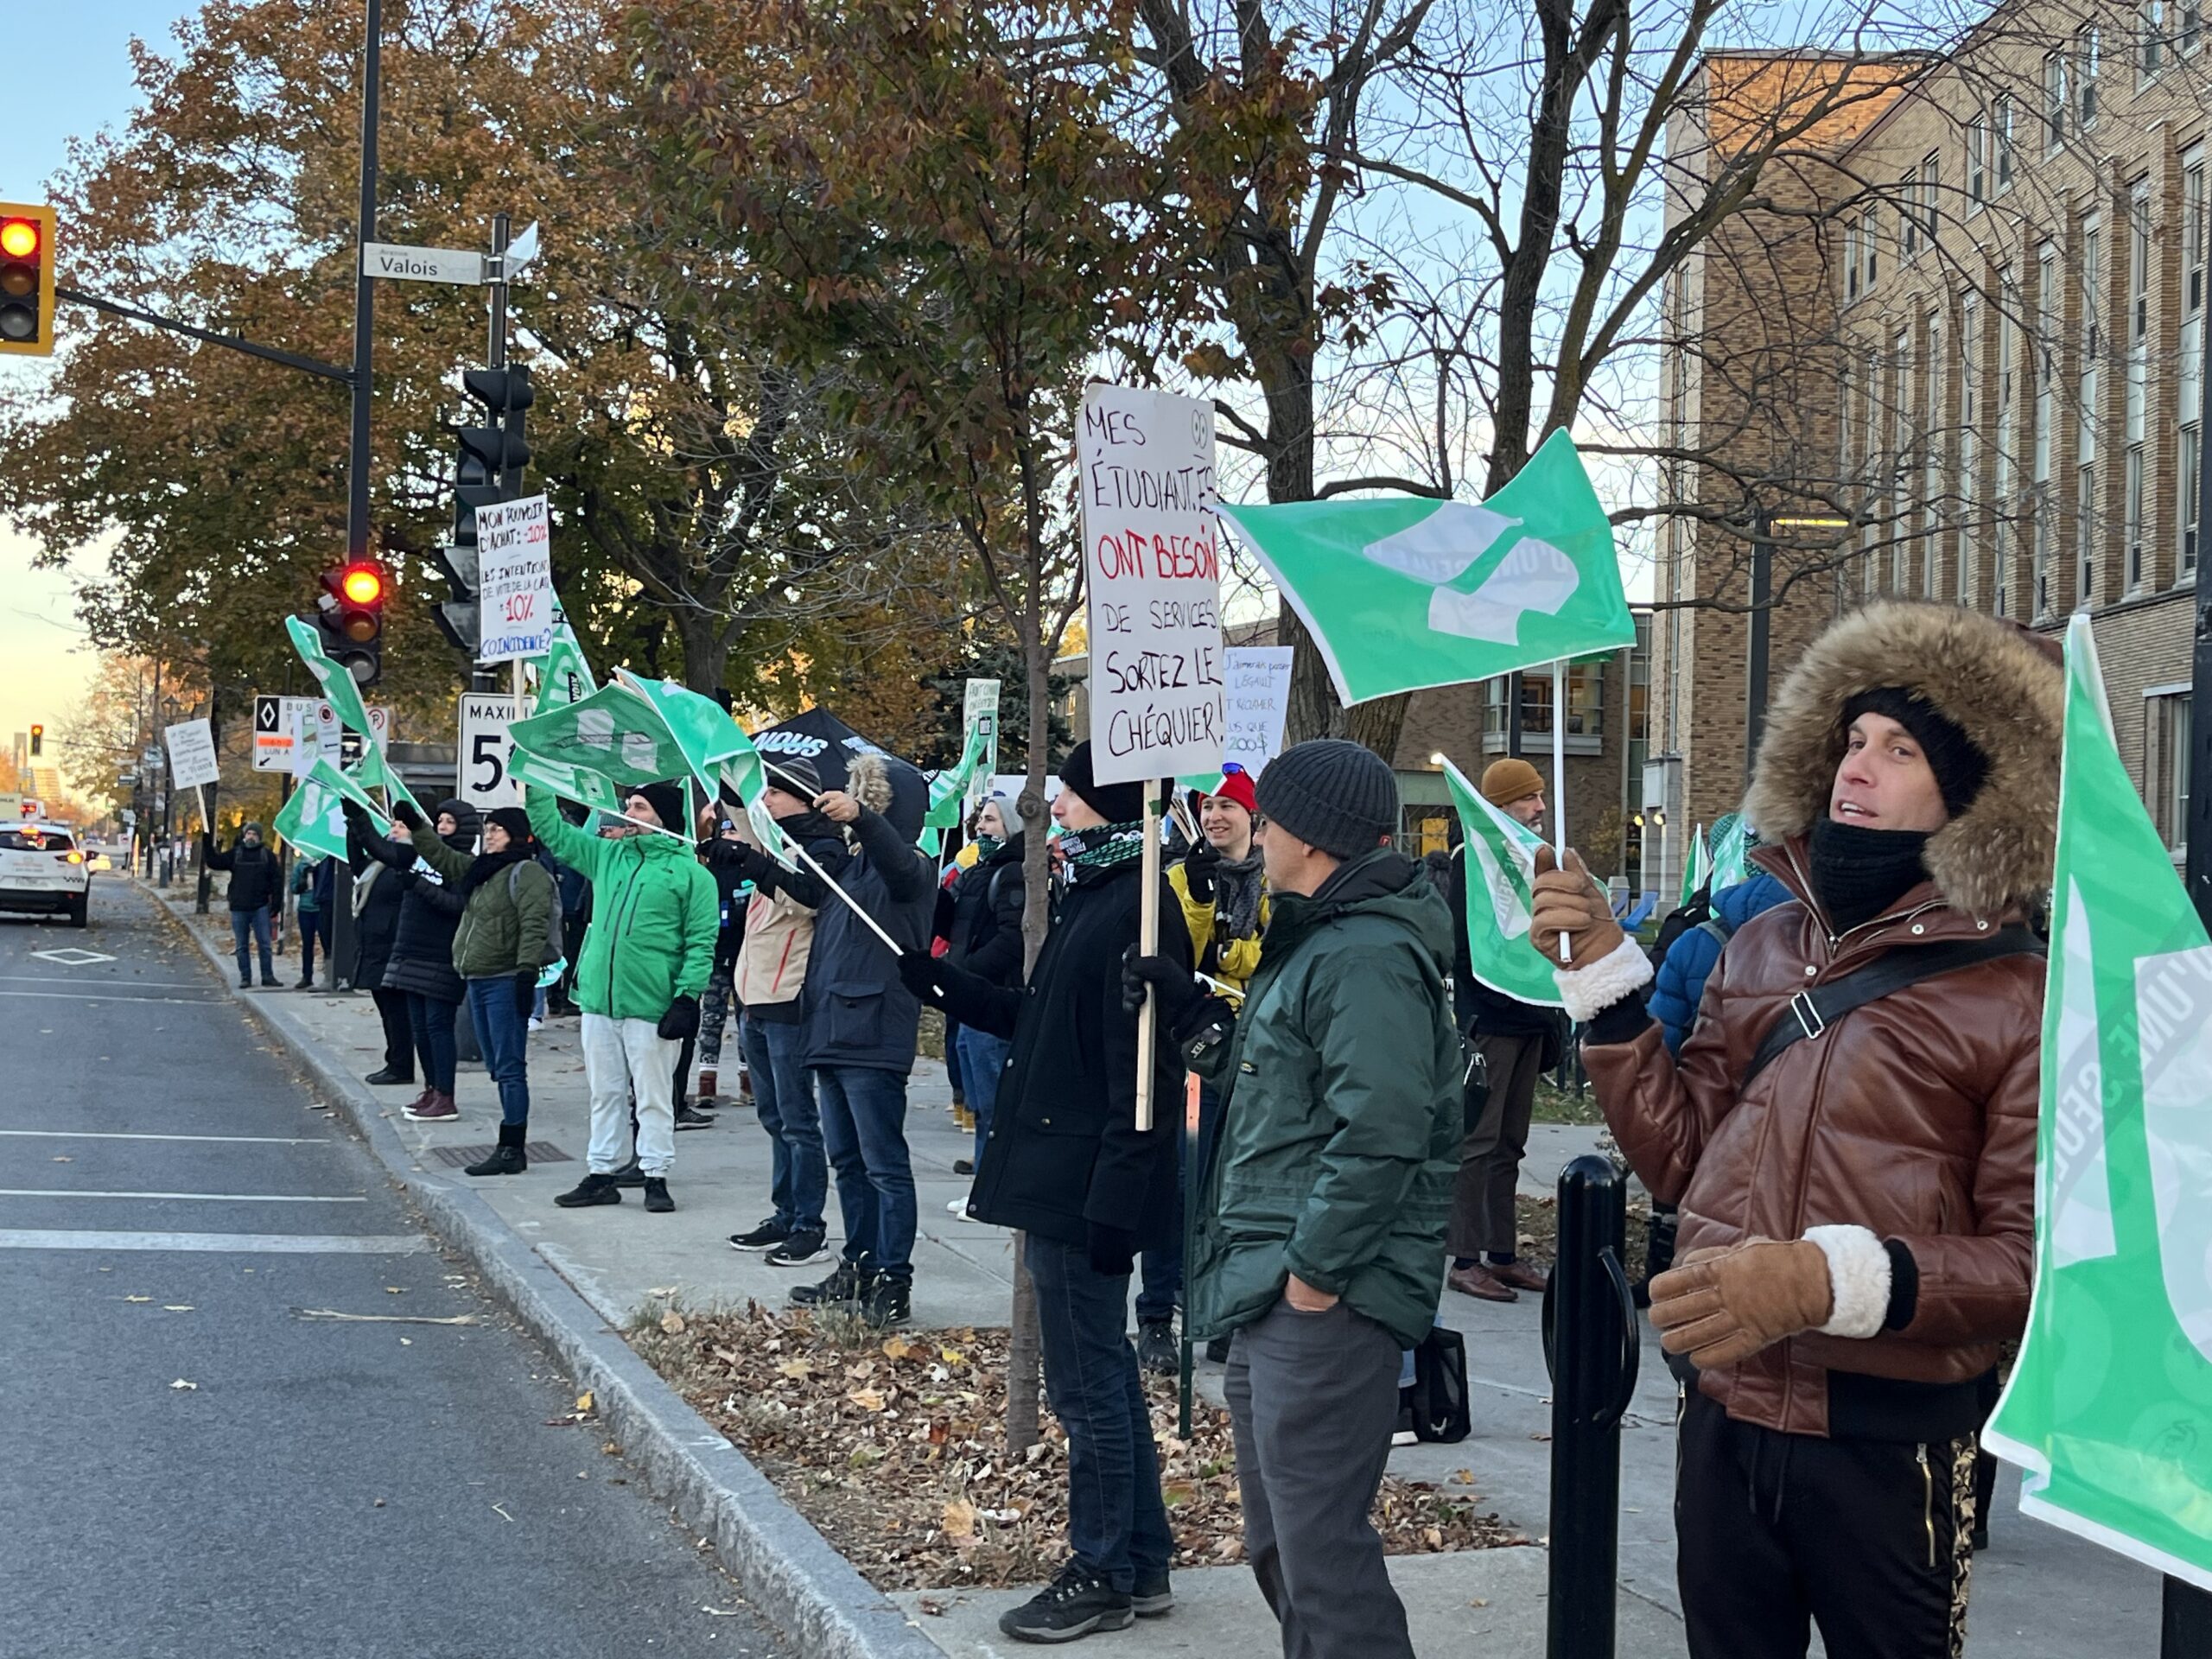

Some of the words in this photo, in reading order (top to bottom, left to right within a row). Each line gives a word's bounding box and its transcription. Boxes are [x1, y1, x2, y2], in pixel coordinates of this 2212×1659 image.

[380, 256, 438, 276] Valois
[1085, 404, 1146, 446] MES
[479, 509, 503, 531] MON
[505, 502, 544, 525] POUVOIR
[1098, 528, 1147, 581] ONT
[1152, 524, 1218, 583] BESOIN
[481, 568, 495, 584] LES
[498, 559, 549, 581] INTENTIONS
[1102, 603, 1131, 633] DE
[481, 627, 552, 658] COINCIDENCE?
[1107, 651, 1188, 693] SORTEZ
[1194, 646, 1223, 686] LE
[753, 732, 828, 757] NOUS
[1109, 702, 1224, 757] CHÉQUIER!
